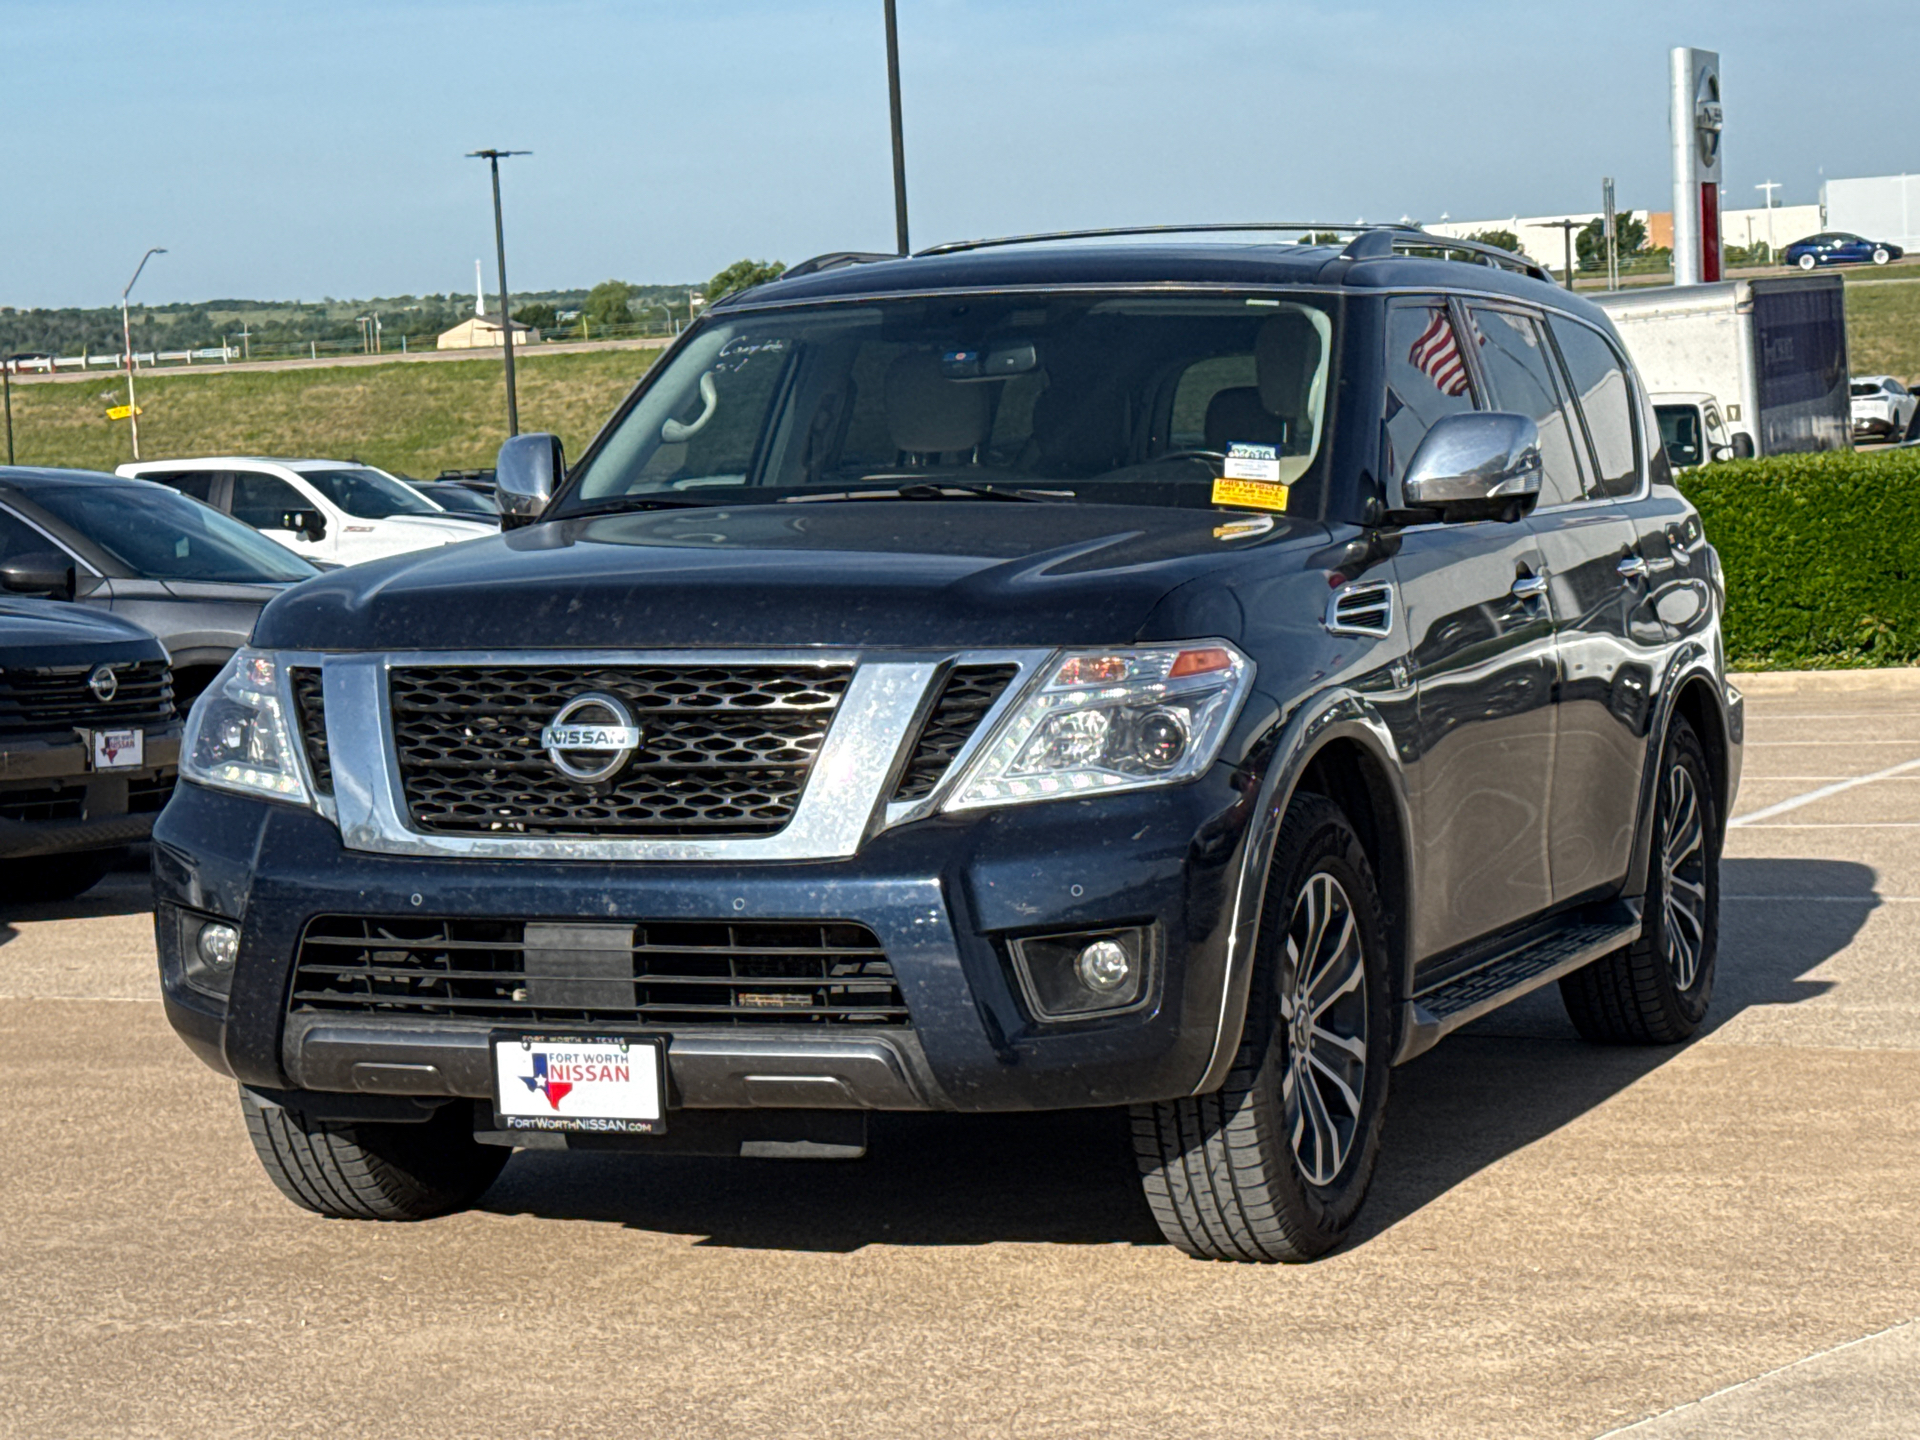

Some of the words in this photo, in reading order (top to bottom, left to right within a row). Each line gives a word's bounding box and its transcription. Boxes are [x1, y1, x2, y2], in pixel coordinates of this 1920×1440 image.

[1219, 480, 1240, 488] THIS
[1243, 481, 1283, 492] VEHICLE
[548, 731, 626, 745] NISSAN
[595, 1037, 625, 1045] TEXAS
[549, 1053, 579, 1064] FORT
[583, 1053, 629, 1064] WORTH
[550, 1064, 630, 1082] NISSAN
